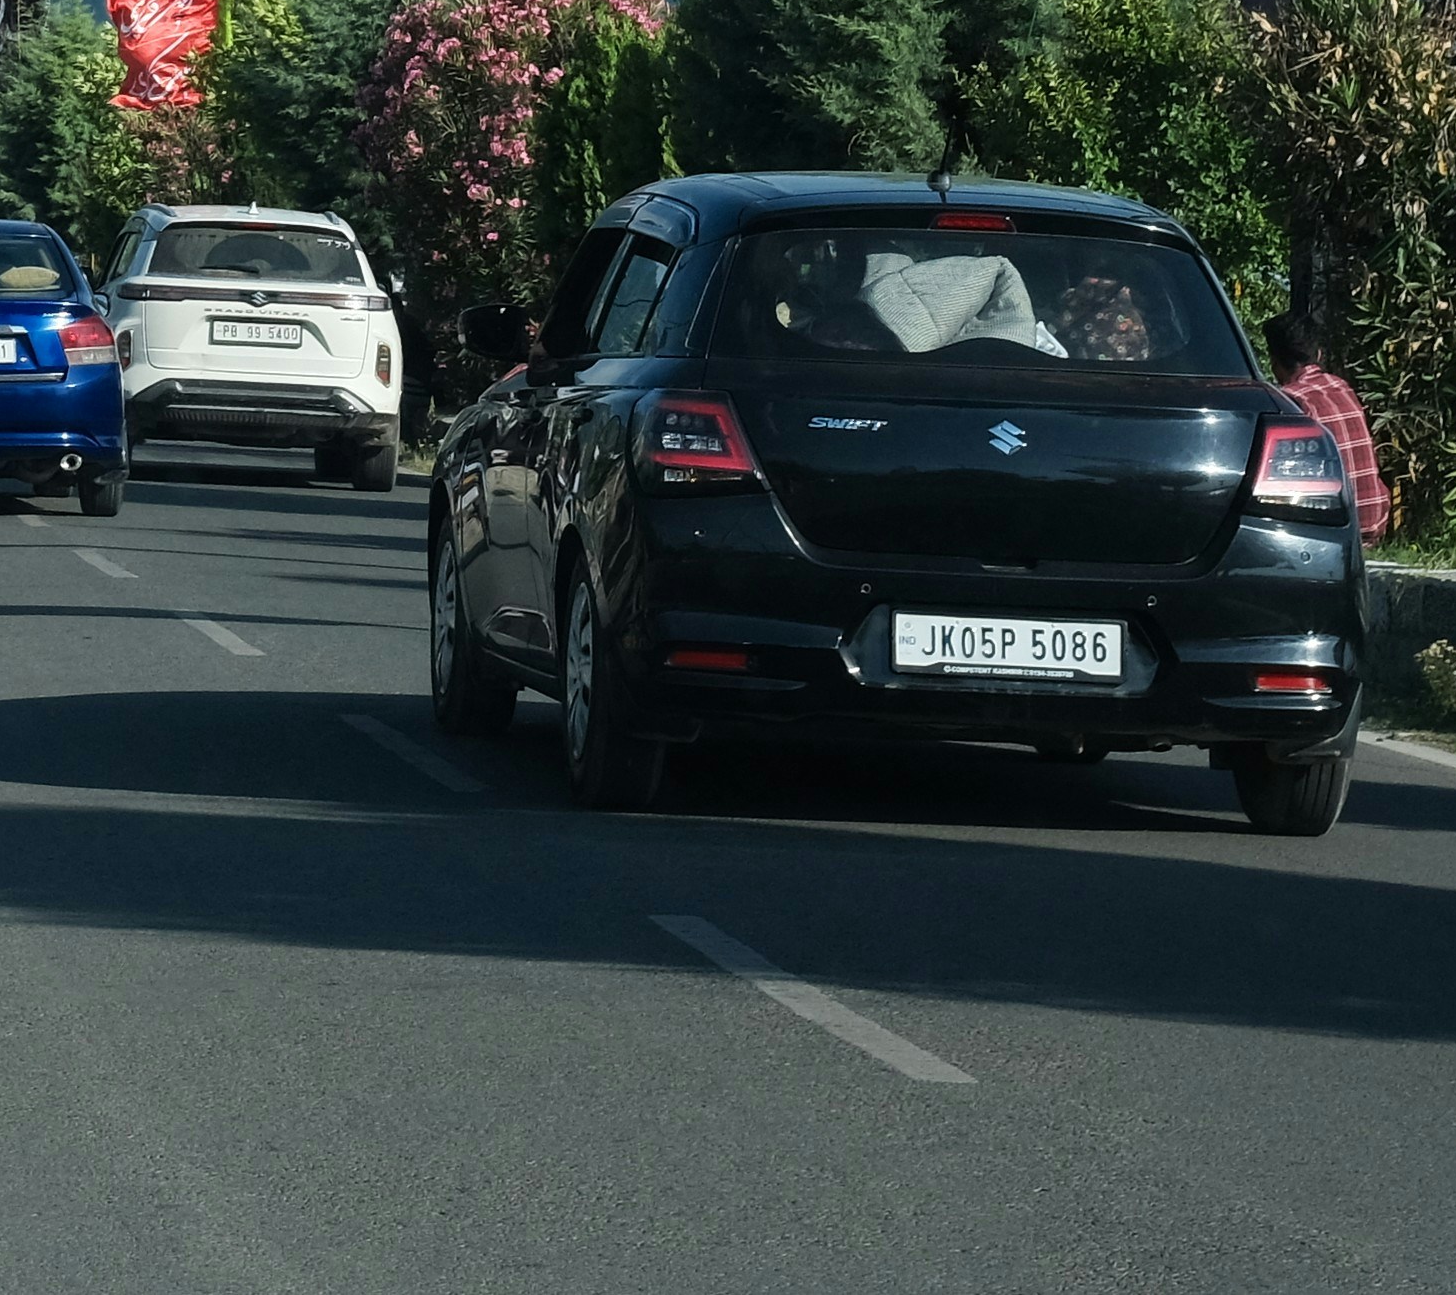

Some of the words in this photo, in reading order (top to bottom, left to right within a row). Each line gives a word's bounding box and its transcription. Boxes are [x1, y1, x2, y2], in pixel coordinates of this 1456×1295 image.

[808, 416, 888, 432] SWIFT
[922, 625, 1016, 660] JK05P
[1031, 628, 1107, 663] 5086
